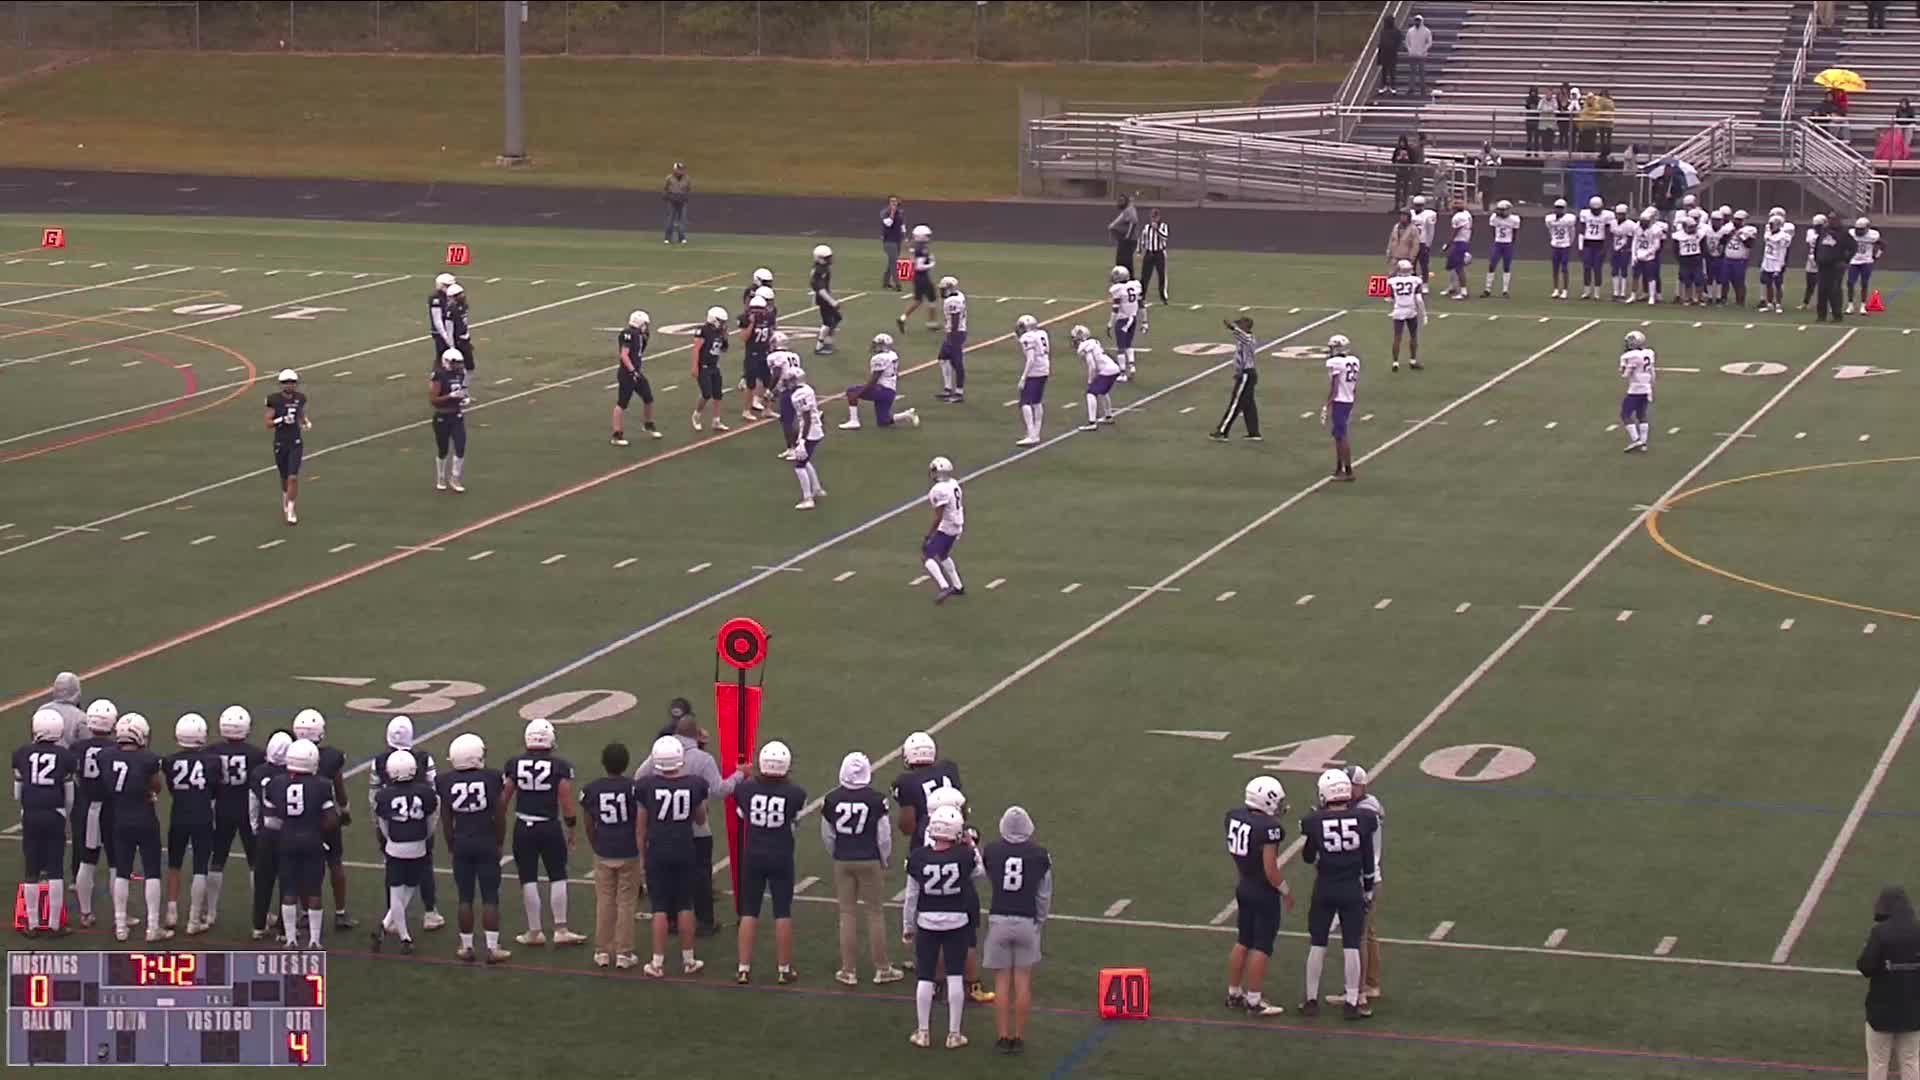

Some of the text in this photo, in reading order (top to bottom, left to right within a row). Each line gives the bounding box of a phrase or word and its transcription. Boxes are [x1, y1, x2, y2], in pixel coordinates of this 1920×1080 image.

[46, 231, 58, 245] G
[448, 247, 465, 263] 10
[1126, 287, 1137, 303] 6
[1369, 277, 1387, 294] 30
[1396, 282, 1413, 296] 23
[29, 752, 57, 785] 12
[112, 760, 129, 792] 7
[172, 759, 207, 790] 24
[219, 755, 248, 786] 13
[516, 760, 552, 791] 52
[286, 783, 304, 816] 9
[450, 781, 487, 812] 23
[599, 792, 629, 824] 51
[655, 789, 691, 821] 70
[749, 794, 786, 828] 88
[834, 802, 870, 835] 27
[1267, 828, 1281, 841] 50
[1227, 818, 1251, 857] 50
[1321, 818, 1361, 852] 55
[922, 863, 961, 896] 22
[1003, 857, 1024, 891] 8
[1104, 974, 1145, 1015] 40
